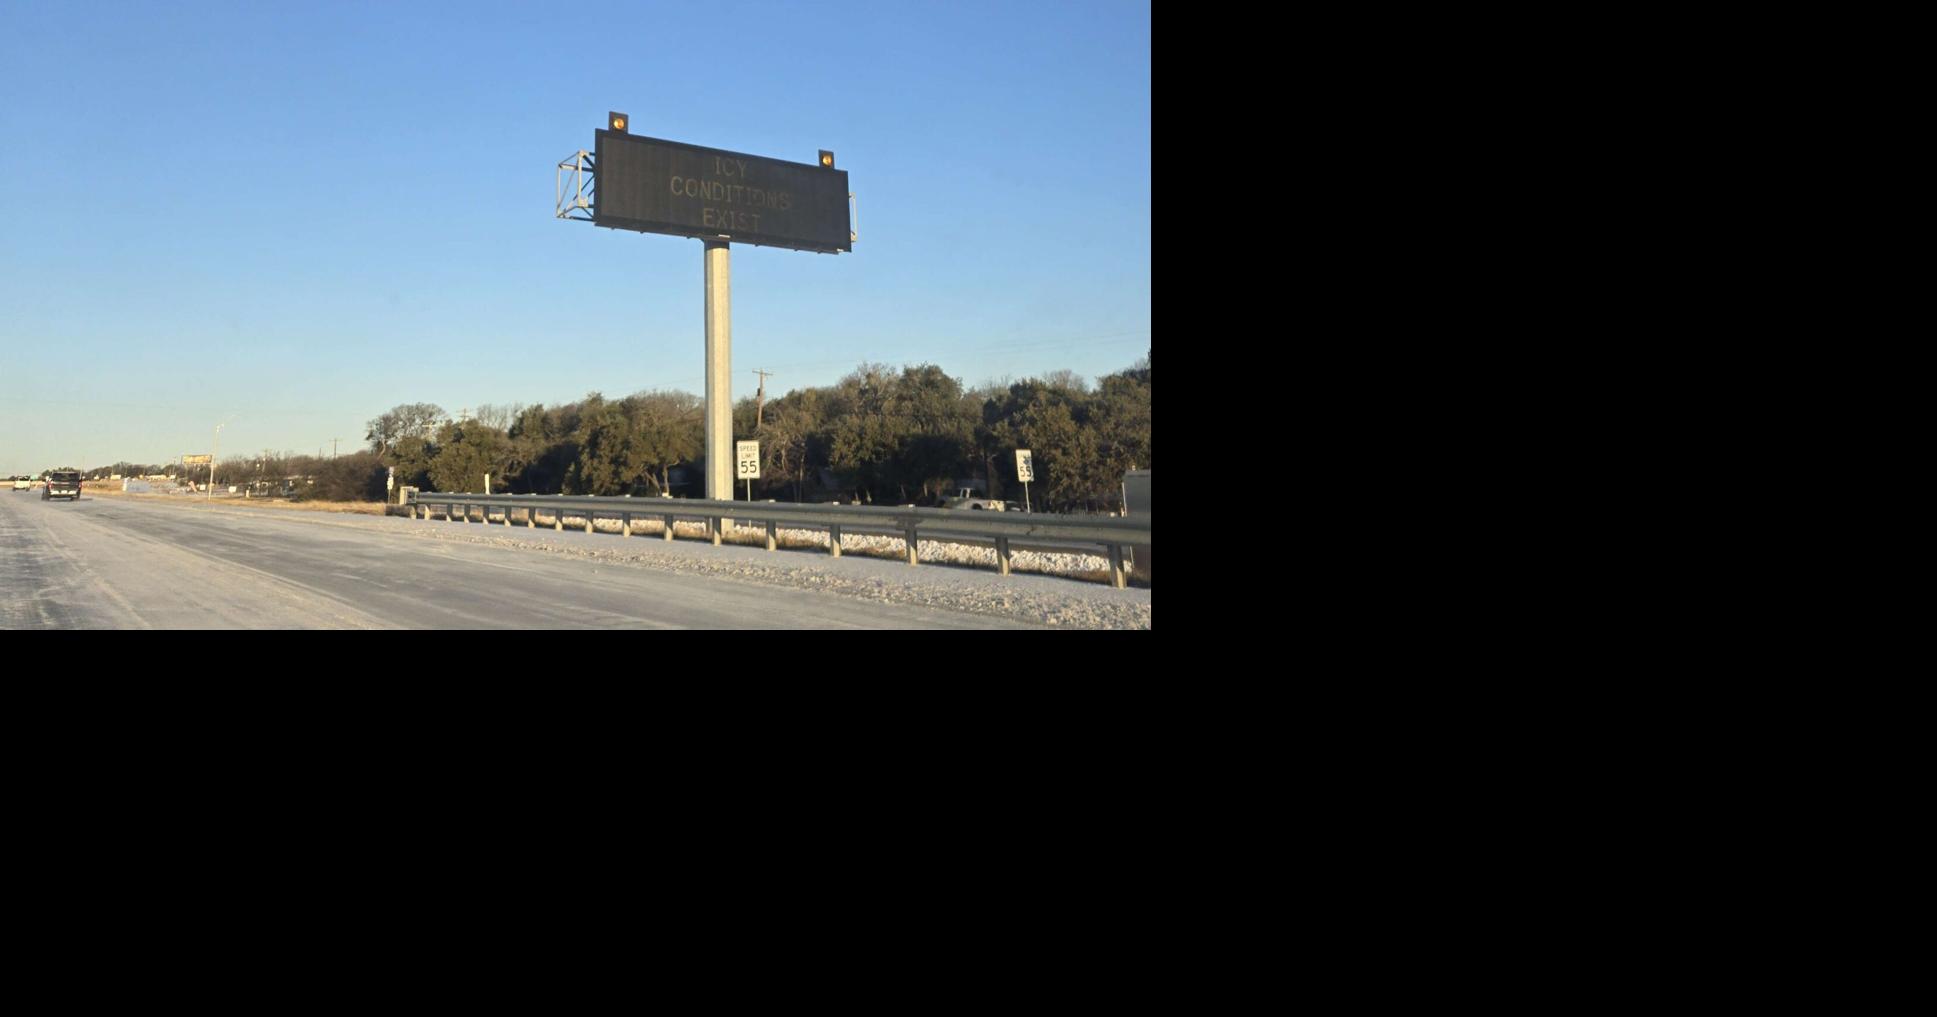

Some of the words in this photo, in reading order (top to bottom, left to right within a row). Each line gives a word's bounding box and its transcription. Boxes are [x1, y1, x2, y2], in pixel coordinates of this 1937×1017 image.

[714, 156, 747, 177] ICY
[671, 175, 791, 210] CONDITIONS
[703, 207, 761, 233] EXIST
[741, 460, 757, 474] 55
